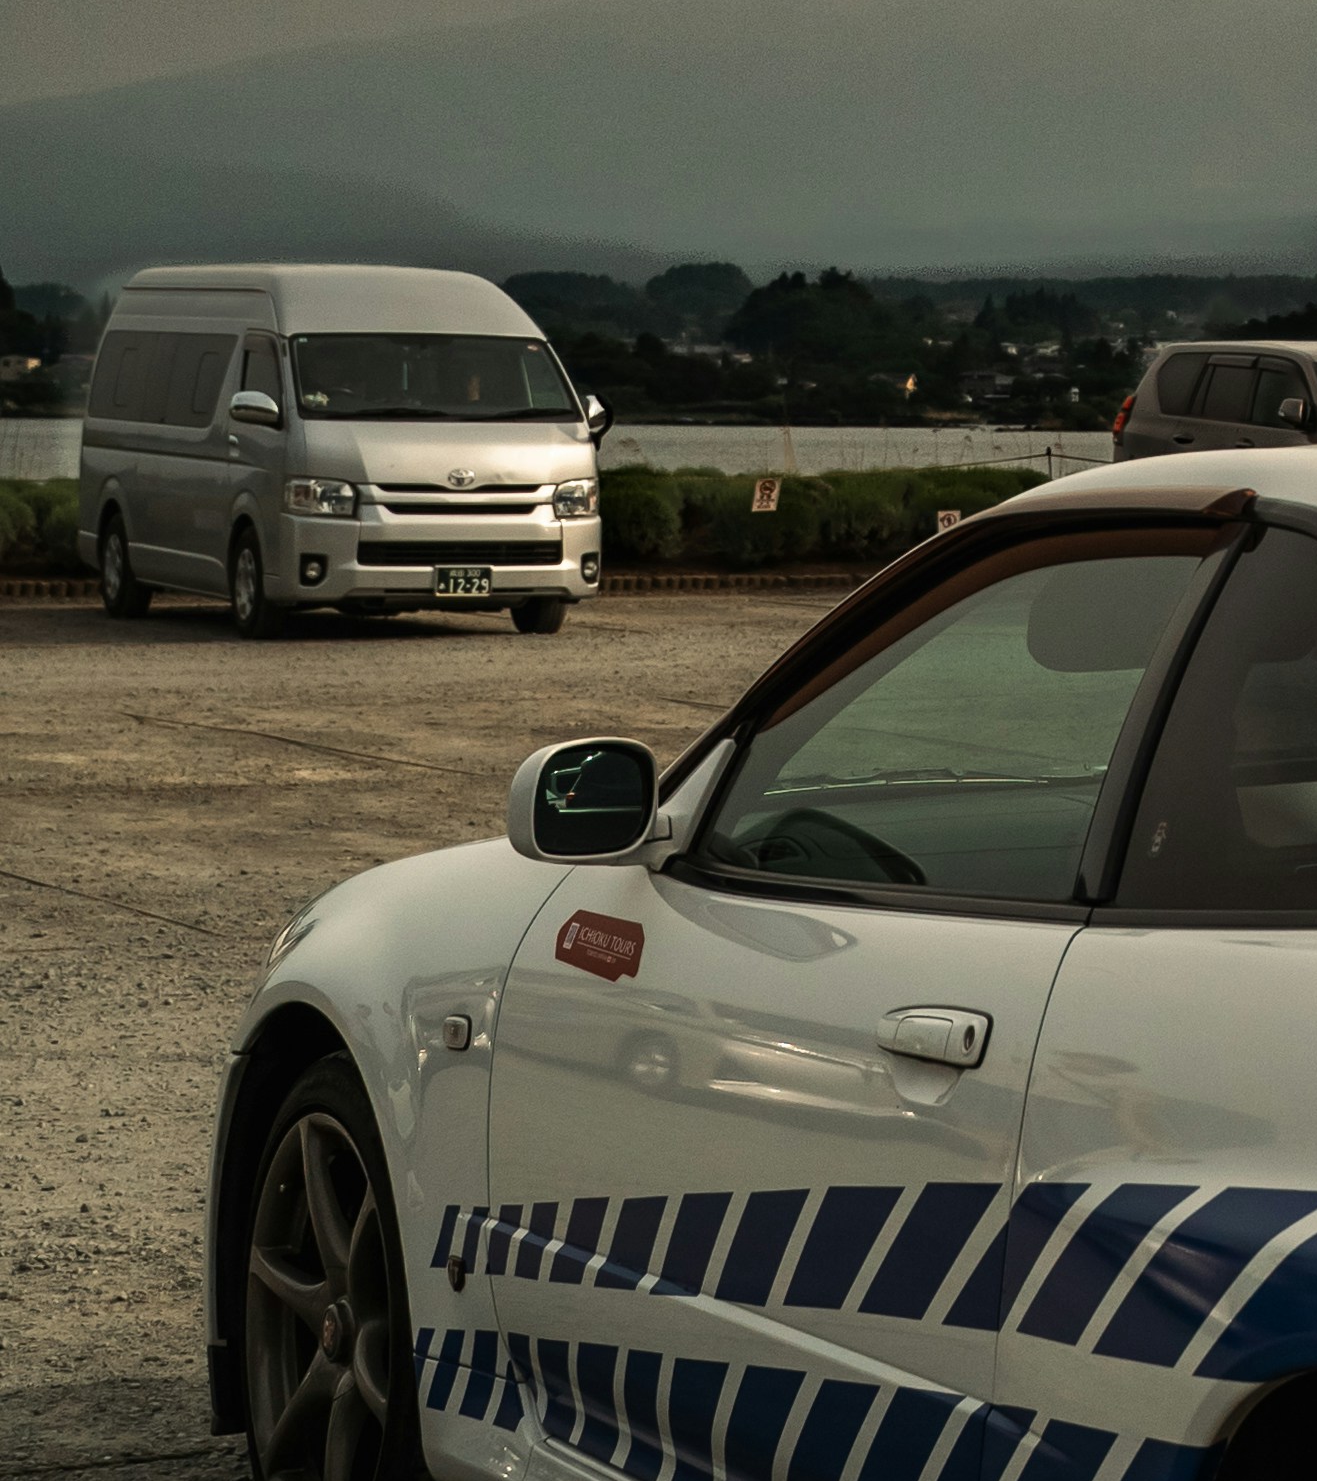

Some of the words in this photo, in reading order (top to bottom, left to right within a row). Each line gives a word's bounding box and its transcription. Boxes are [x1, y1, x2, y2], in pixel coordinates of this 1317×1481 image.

[450, 578, 489, 594] 12-29
[578, 926, 612, 948] ICHIOKU
[611, 935, 636, 956] TOURS
